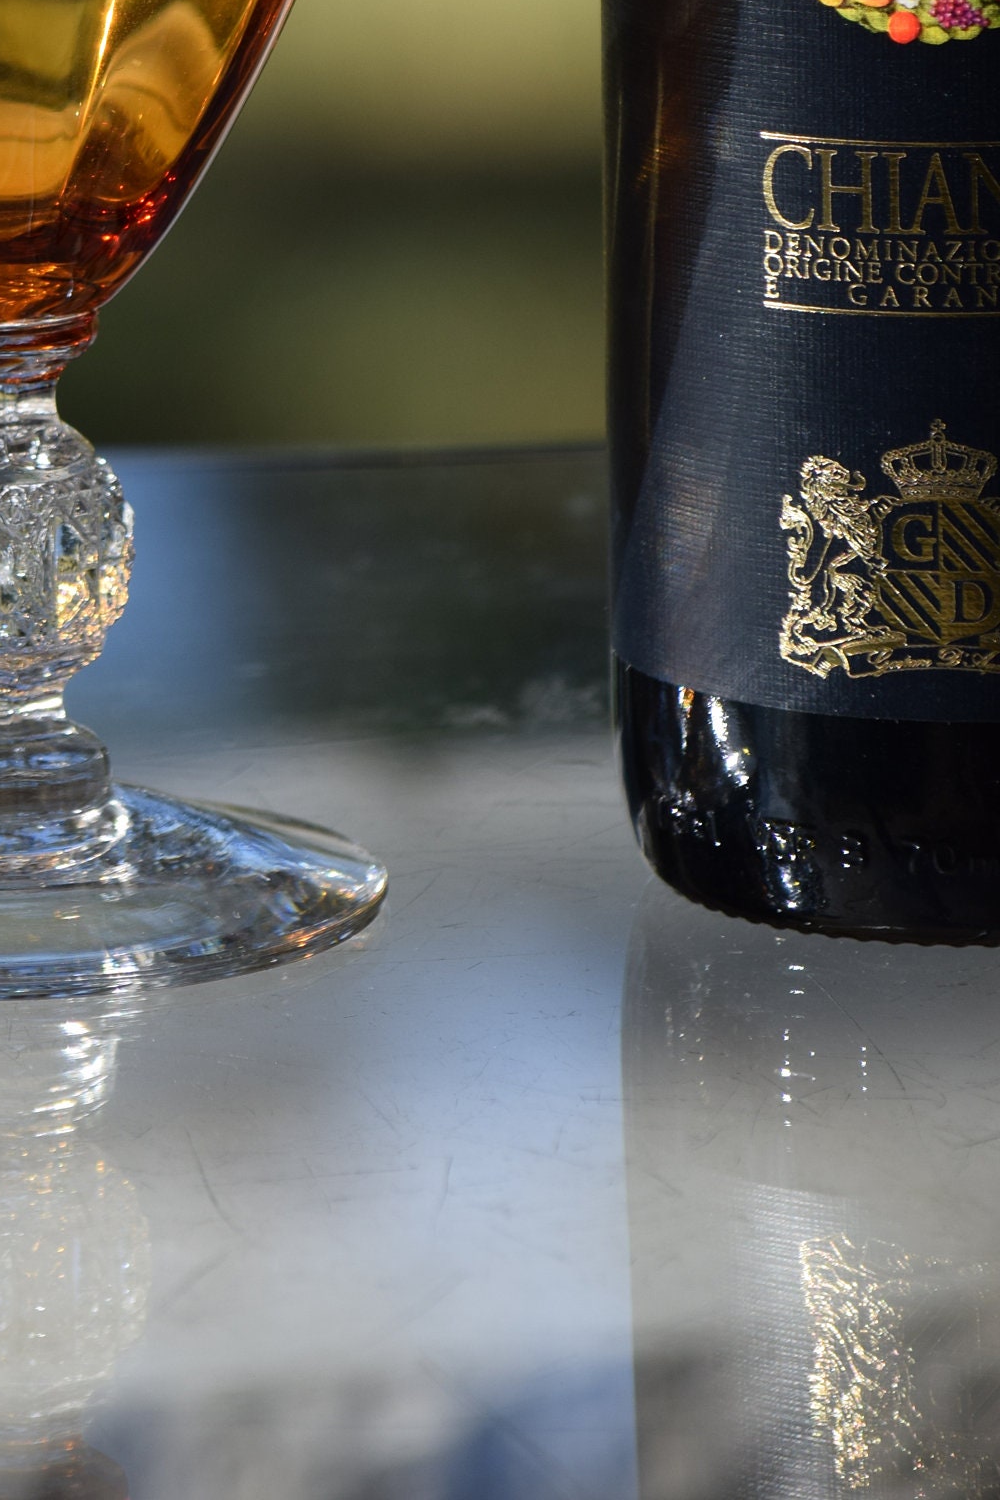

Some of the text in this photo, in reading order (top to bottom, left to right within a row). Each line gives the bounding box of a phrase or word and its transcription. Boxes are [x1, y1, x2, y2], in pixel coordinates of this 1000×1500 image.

[763, 253, 883, 284] ORIGINE
[764, 276, 1000, 308] E GARAN
[892, 513, 937, 563] G
[950, 580, 994, 624] D
